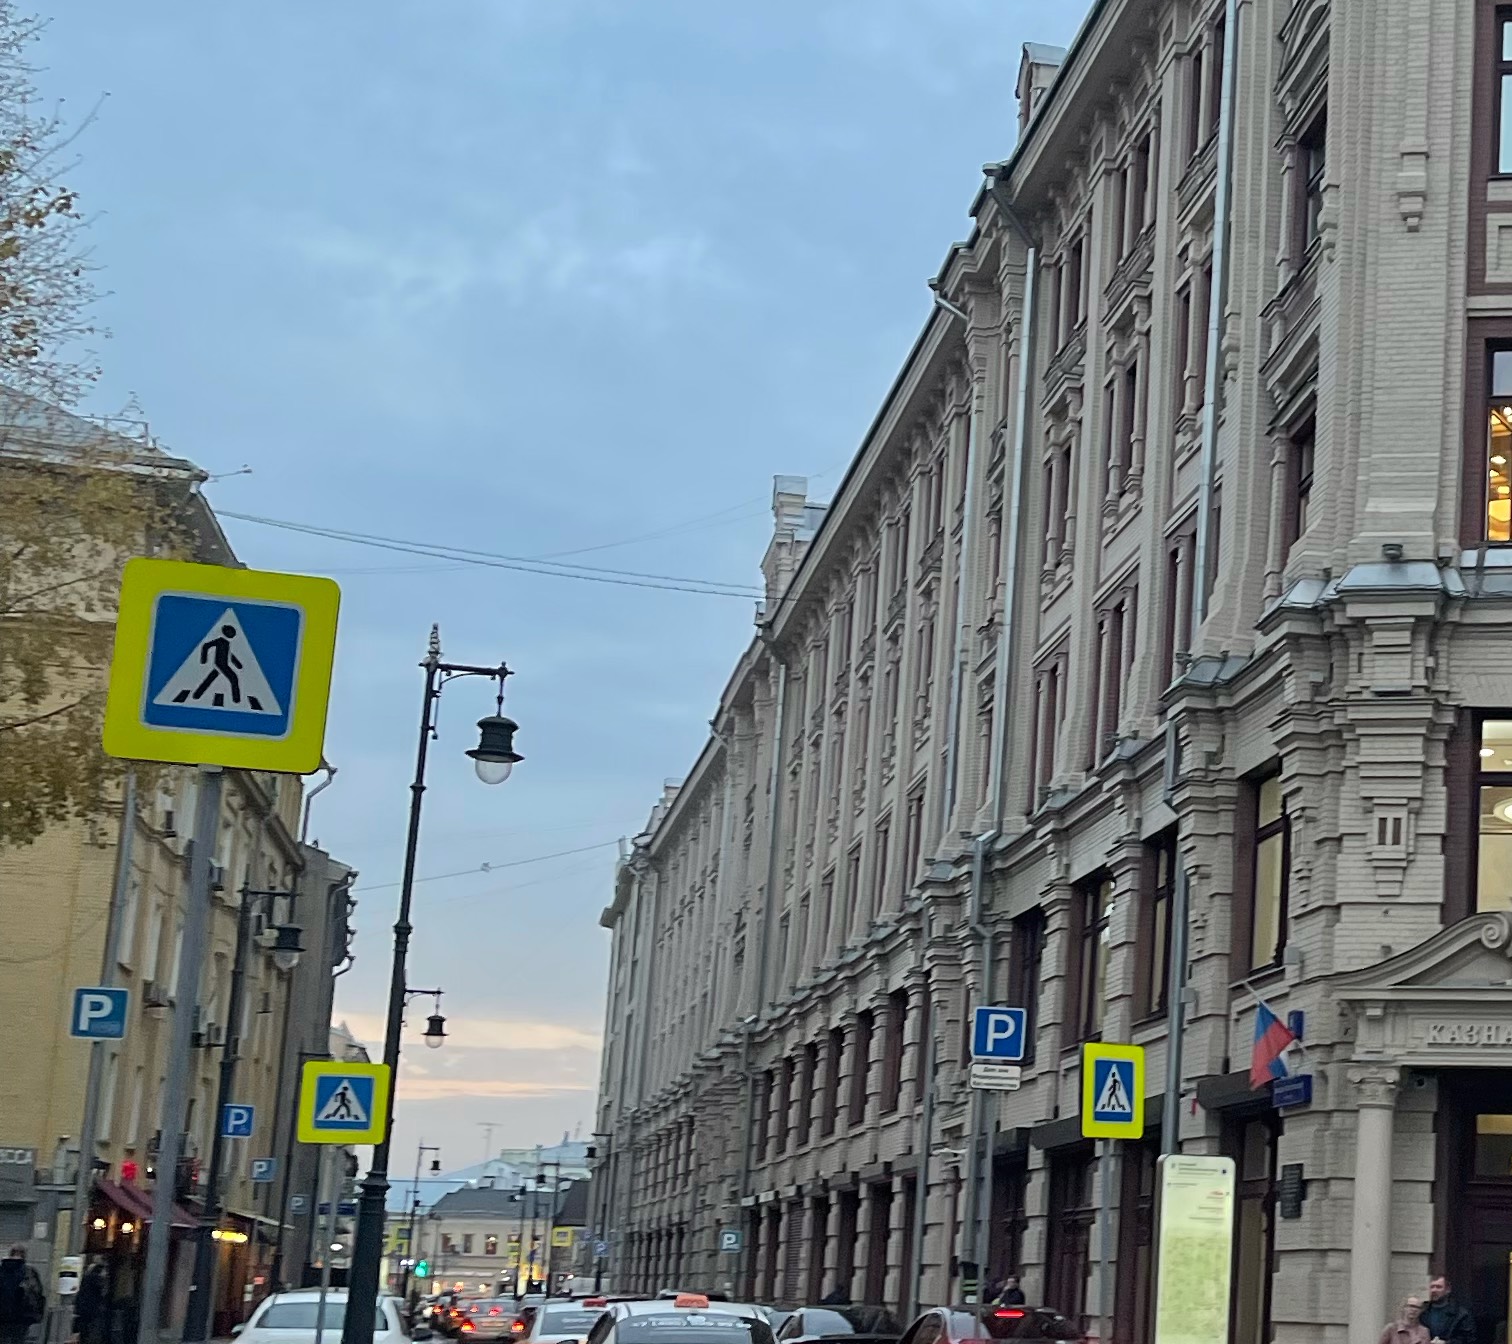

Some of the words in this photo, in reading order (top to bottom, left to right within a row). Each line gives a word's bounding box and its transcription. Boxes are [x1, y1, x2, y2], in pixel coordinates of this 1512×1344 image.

[79, 994, 113, 1031] P
[986, 1013, 1016, 1053] P
[227, 1108, 248, 1134] P
[252, 1161, 268, 1178] P
[722, 1233, 737, 1249] P
